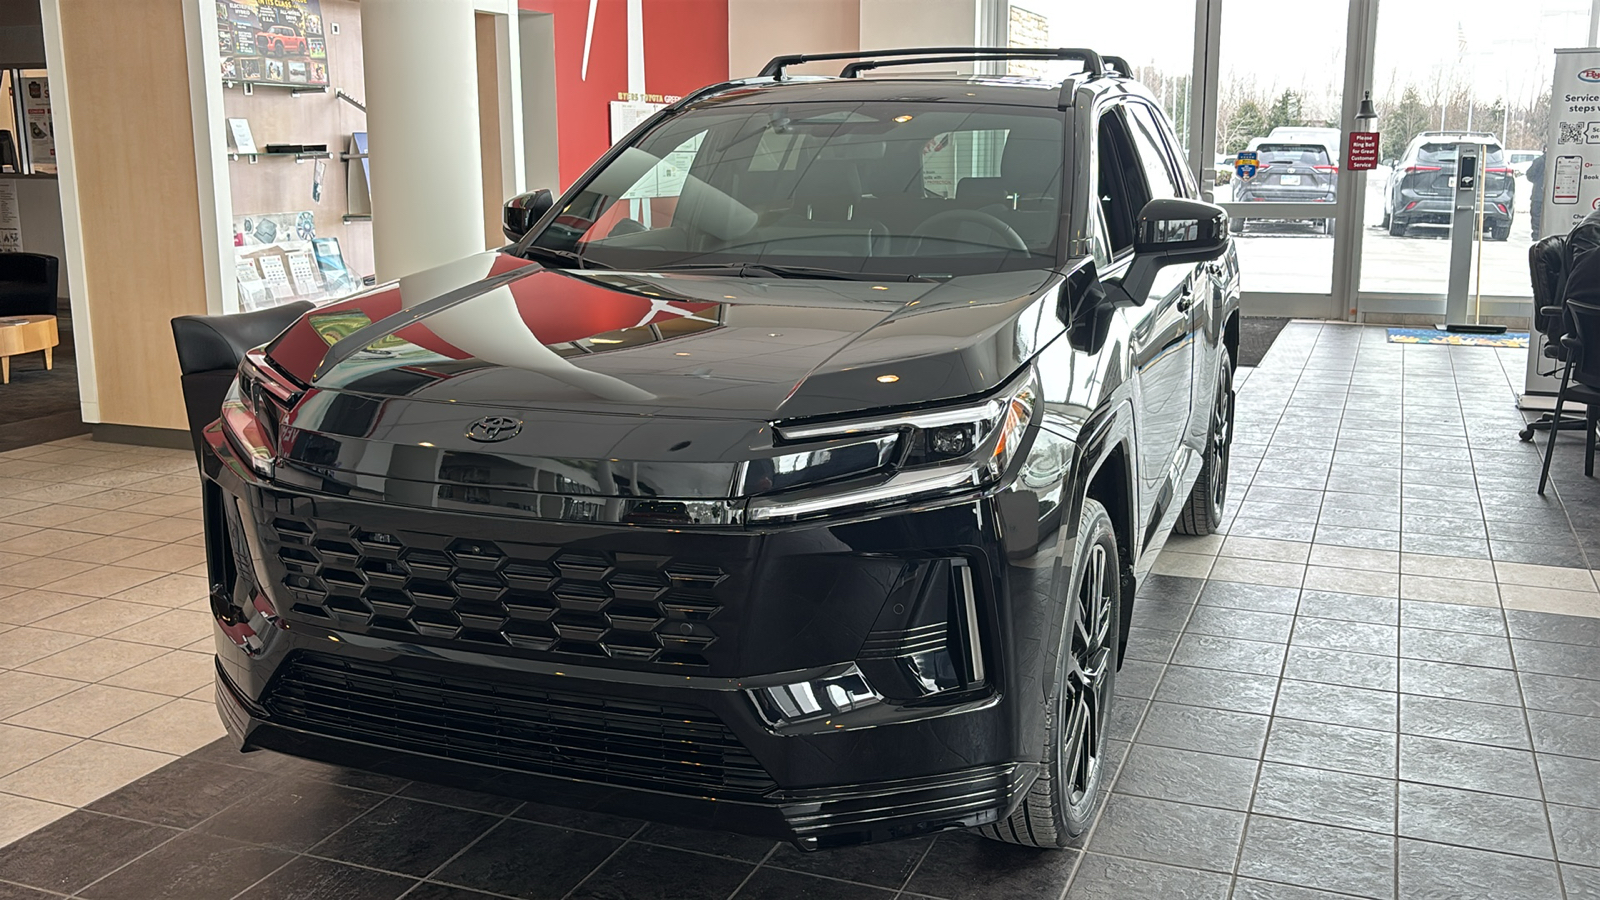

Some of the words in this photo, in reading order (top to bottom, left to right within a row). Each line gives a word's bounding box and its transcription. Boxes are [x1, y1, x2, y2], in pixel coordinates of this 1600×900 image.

[617, 92, 639, 101] BYERS
[640, 94, 664, 103] TOYOTA
[1565, 94, 1599, 102] Service
[1569, 105, 1596, 113] steps
